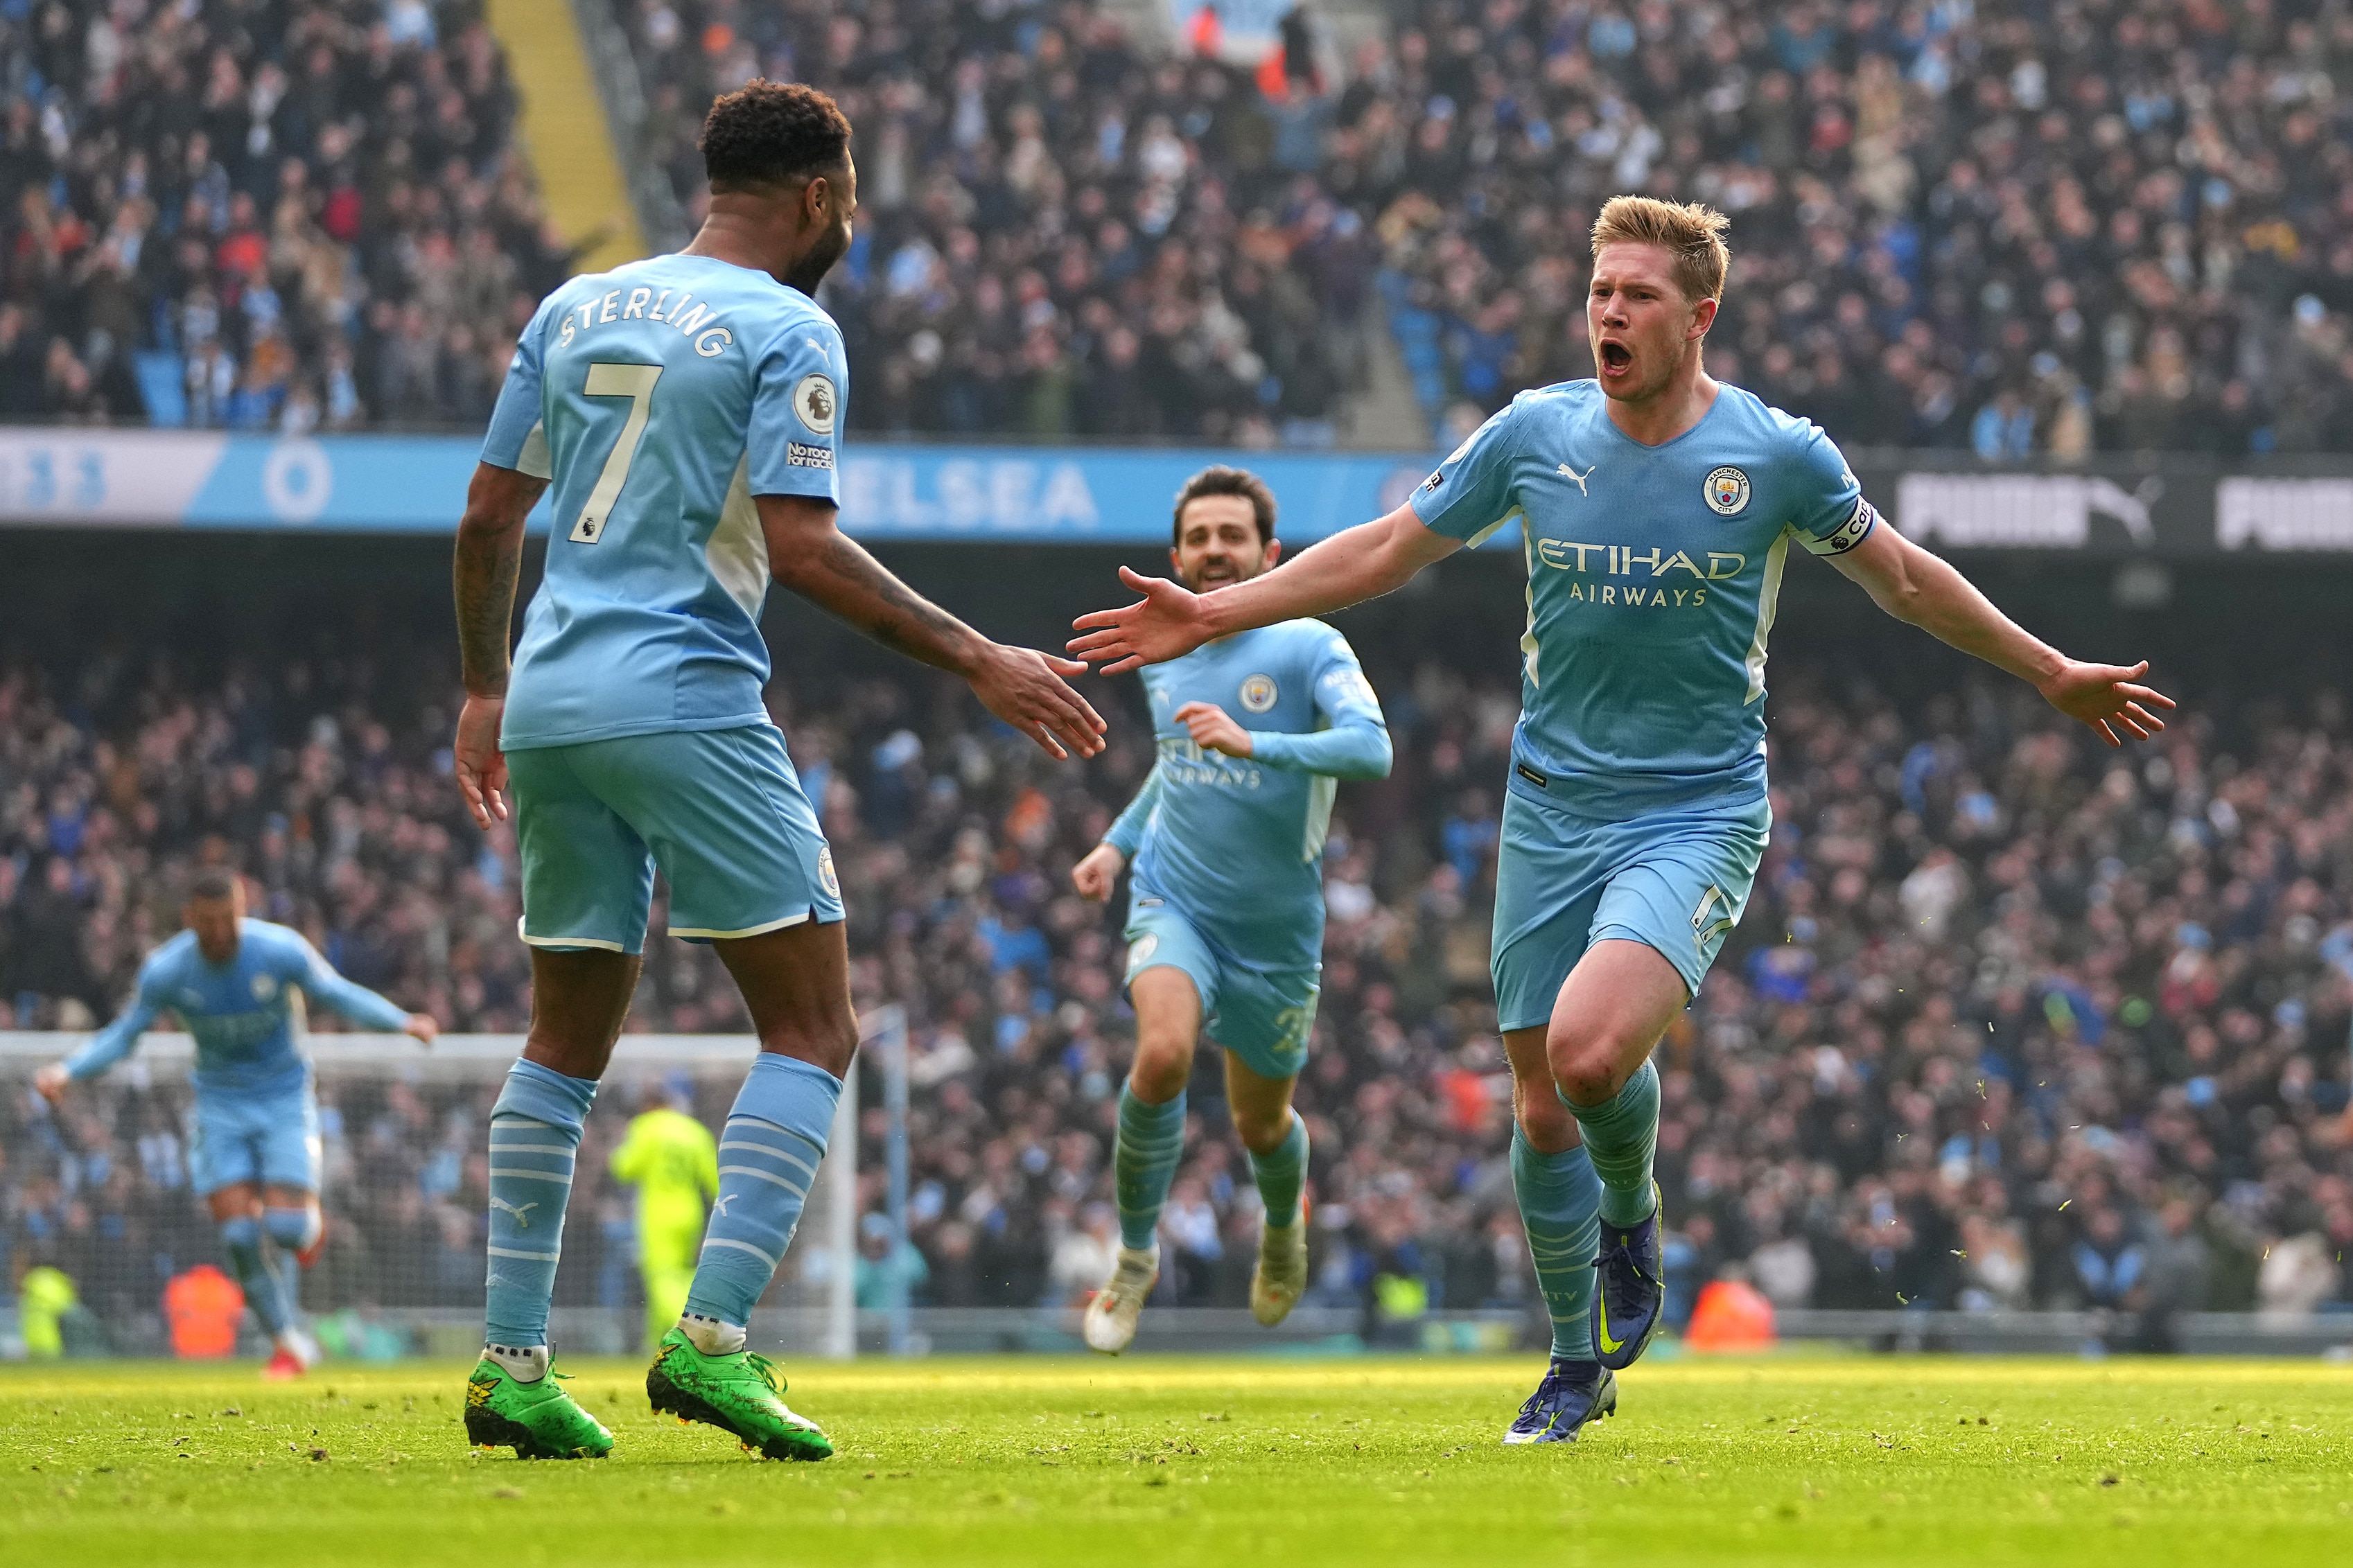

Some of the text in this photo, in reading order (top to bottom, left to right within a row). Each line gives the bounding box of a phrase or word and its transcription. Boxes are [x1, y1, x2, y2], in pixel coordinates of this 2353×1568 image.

[560, 287, 733, 358] STERLING
[568, 362, 664, 545] 7
[788, 442, 807, 456] No
[807, 457, 833, 470] racis
[1708, 468, 1748, 487] MANCHESTER
[841, 457, 1100, 529] ELSEA
[1848, 502, 1870, 535] Cap
[1537, 538, 1746, 580] ETIHAD
[1570, 582, 1707, 607] AIRWAYS
[1543, 1290, 1578, 1301] ITY
